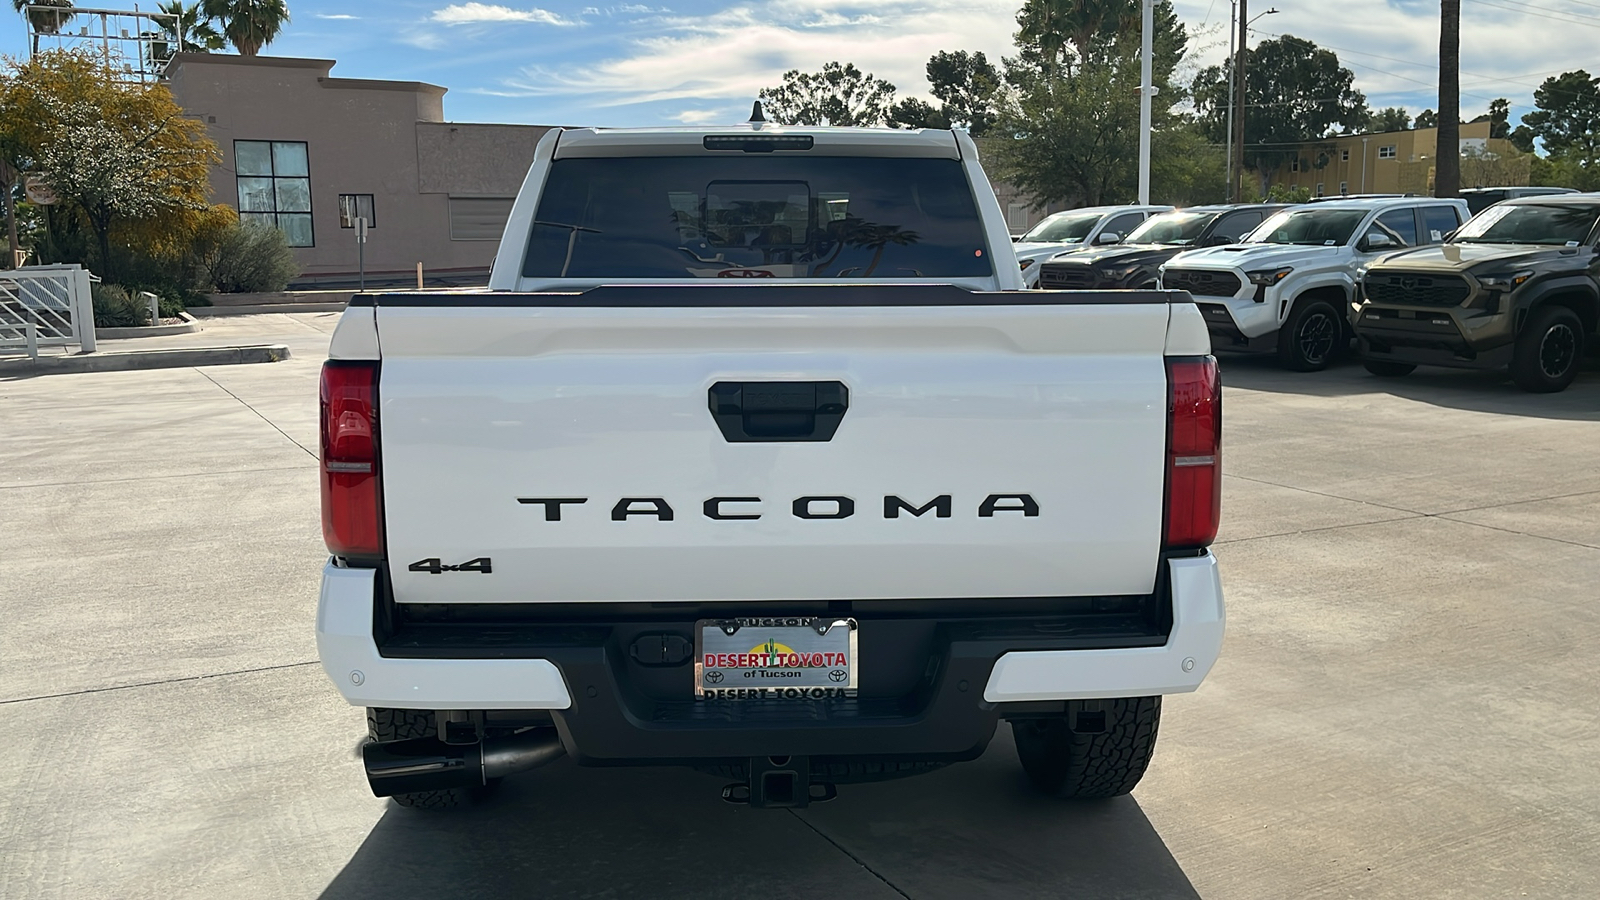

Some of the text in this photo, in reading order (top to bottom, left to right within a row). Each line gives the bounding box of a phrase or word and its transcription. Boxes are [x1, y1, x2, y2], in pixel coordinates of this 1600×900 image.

[517, 494, 1041, 522] TACOMA
[408, 557, 492, 574] 4x4
[738, 617, 812, 627] TUCSON
[704, 652, 847, 668] DESERT TOYOTA
[743, 669, 802, 678] of Tucson
[703, 687, 847, 700] DESERT TOYOTA
